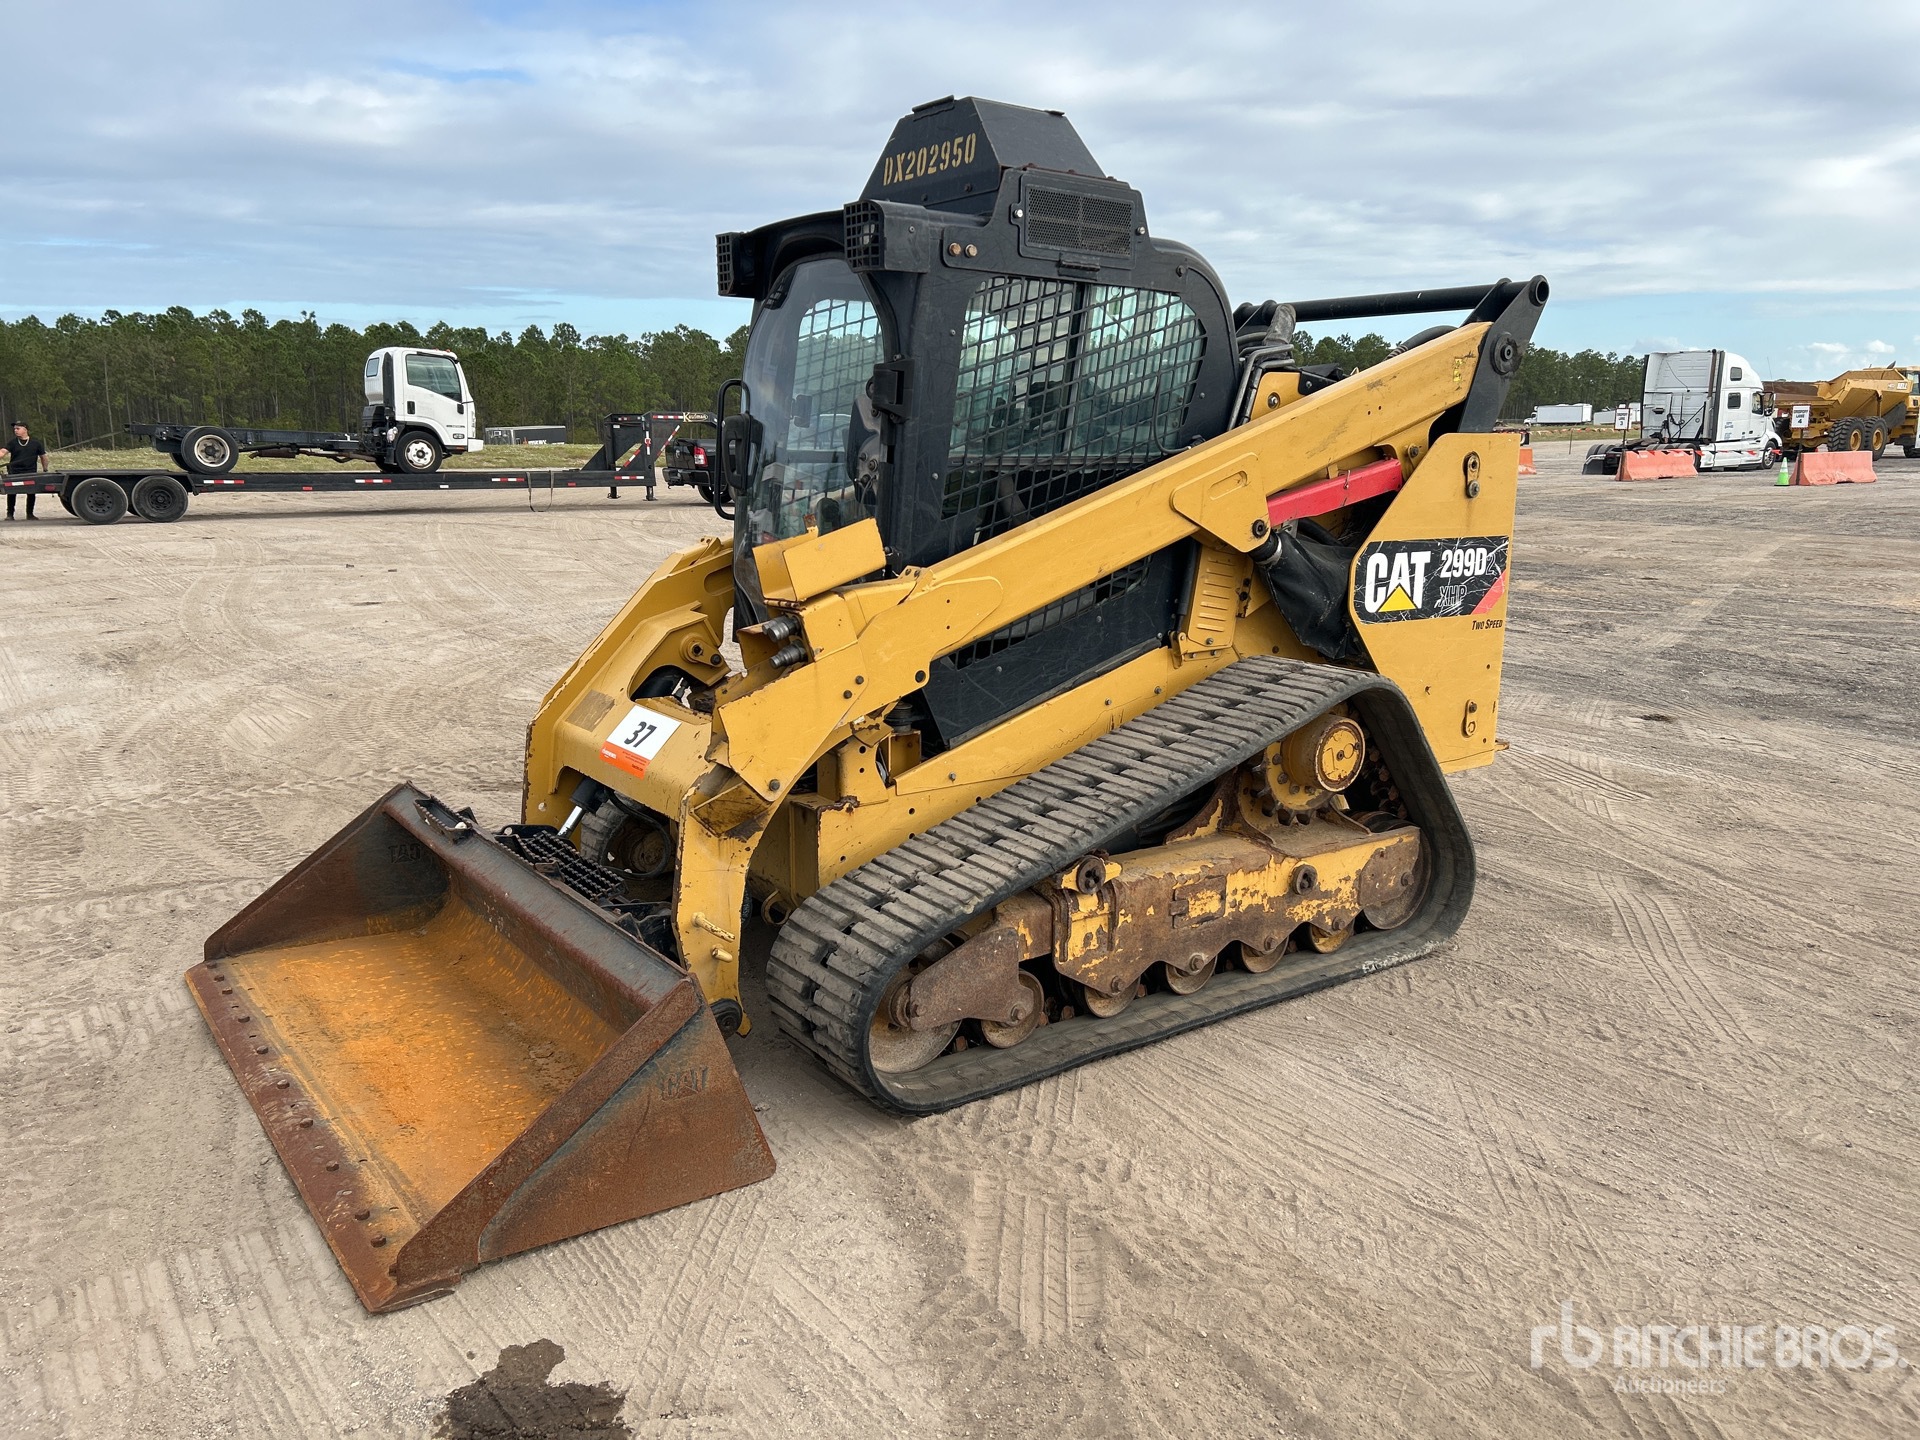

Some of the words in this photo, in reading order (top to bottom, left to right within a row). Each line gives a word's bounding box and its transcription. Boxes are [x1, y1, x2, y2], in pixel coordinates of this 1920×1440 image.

[882, 132, 977, 187] DX202950
[1364, 550, 1432, 614] CAT
[623, 721, 658, 748] 37
